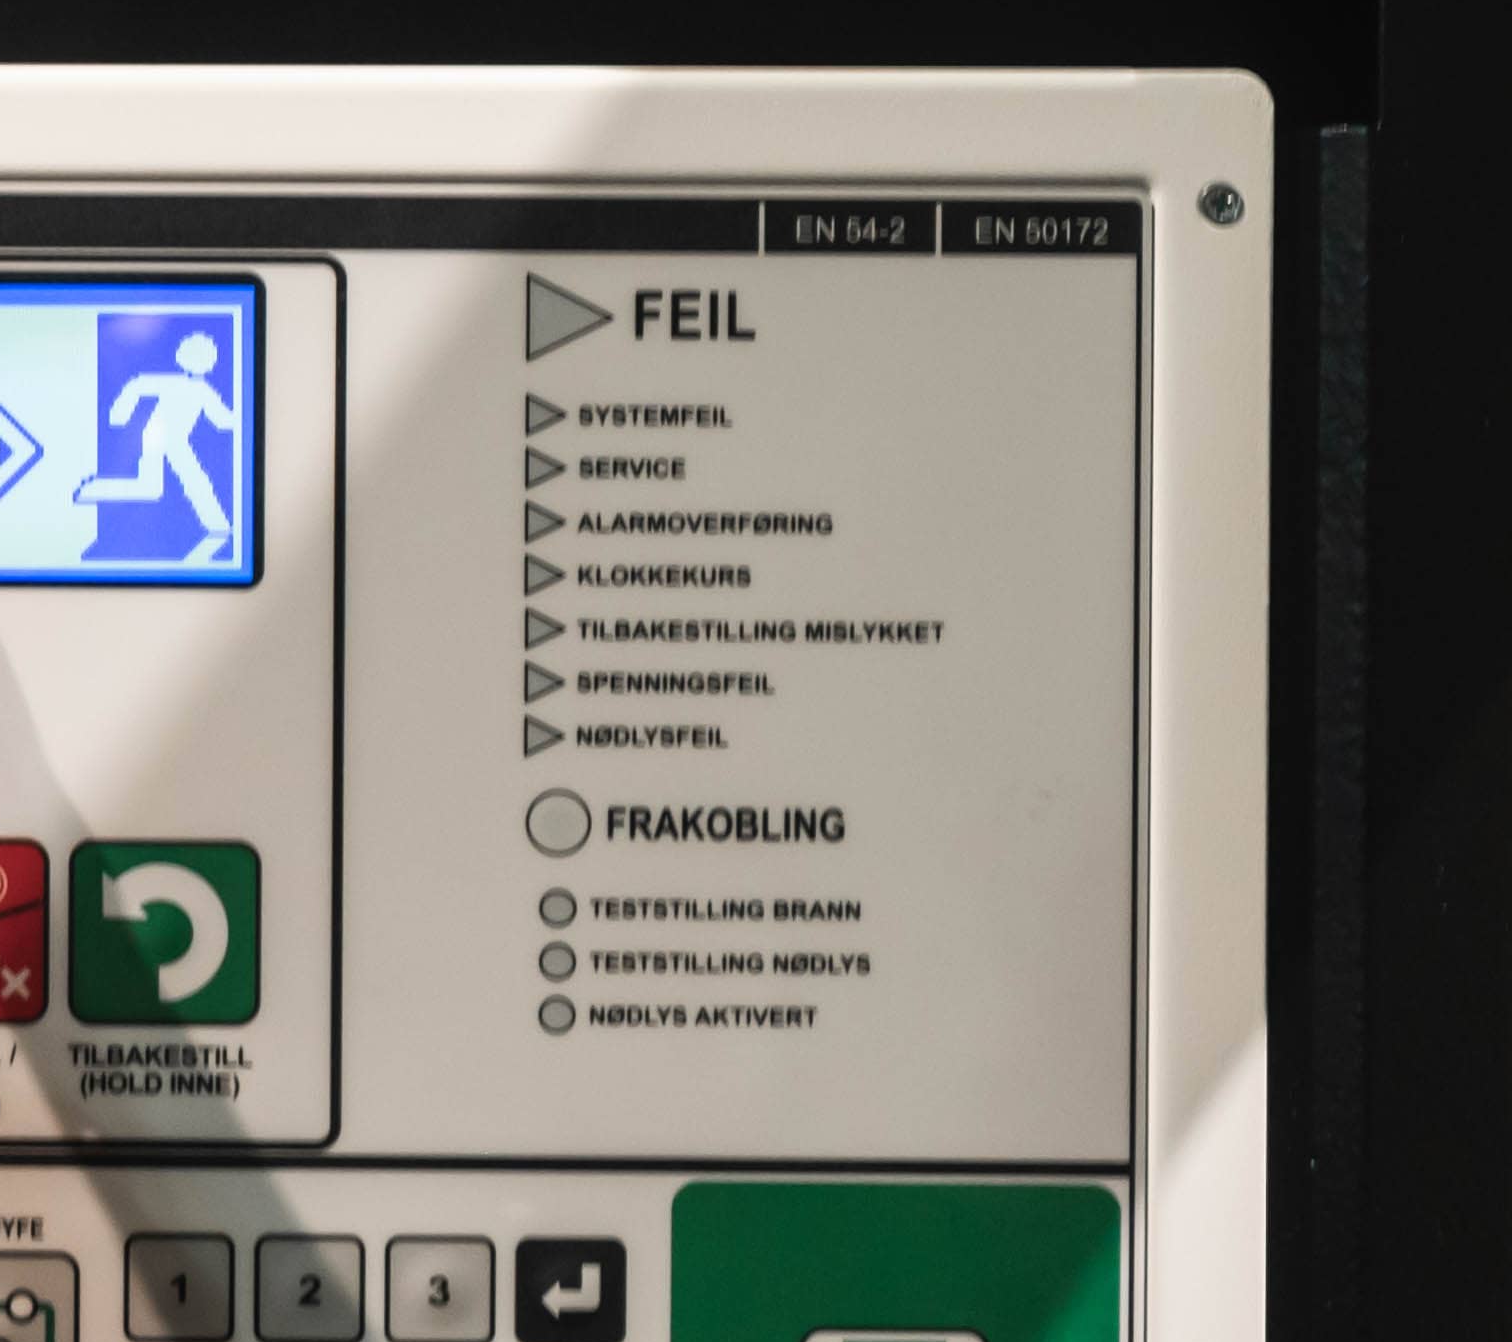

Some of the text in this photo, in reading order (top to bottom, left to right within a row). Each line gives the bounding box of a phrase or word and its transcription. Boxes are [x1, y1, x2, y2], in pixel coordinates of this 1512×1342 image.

[795, 215, 906, 245] EN 54-2
[974, 216, 1109, 246] EN 50172
[633, 288, 757, 342] FEIL
[578, 404, 731, 428] SYSTEMFEIL
[578, 456, 686, 480] SERVICE
[577, 511, 834, 536] ALARMOVERFØRING
[577, 564, 752, 589] KLOKKEKURS
[578, 618, 944, 645] TILBAKESTILLING MISLYKKET
[576, 671, 774, 696] SPENNINGSFEIL
[575, 724, 728, 749] NØDLYSFEIL
[606, 805, 846, 844] FRAKOBLING
[590, 897, 862, 922] TESTSTILLING BRANN
[590, 951, 871, 976] TESTSTILLING NØDLYS
[588, 1004, 817, 1029] NØDLYS AKTIVERT
[69, 1042, 253, 1067] TILBAKESTILL
[80, 1073, 241, 1101] (HOLD INNE)
[169, 1272, 188, 1306] 1
[297, 1273, 322, 1309] 2
[428, 1275, 452, 1310] 3
